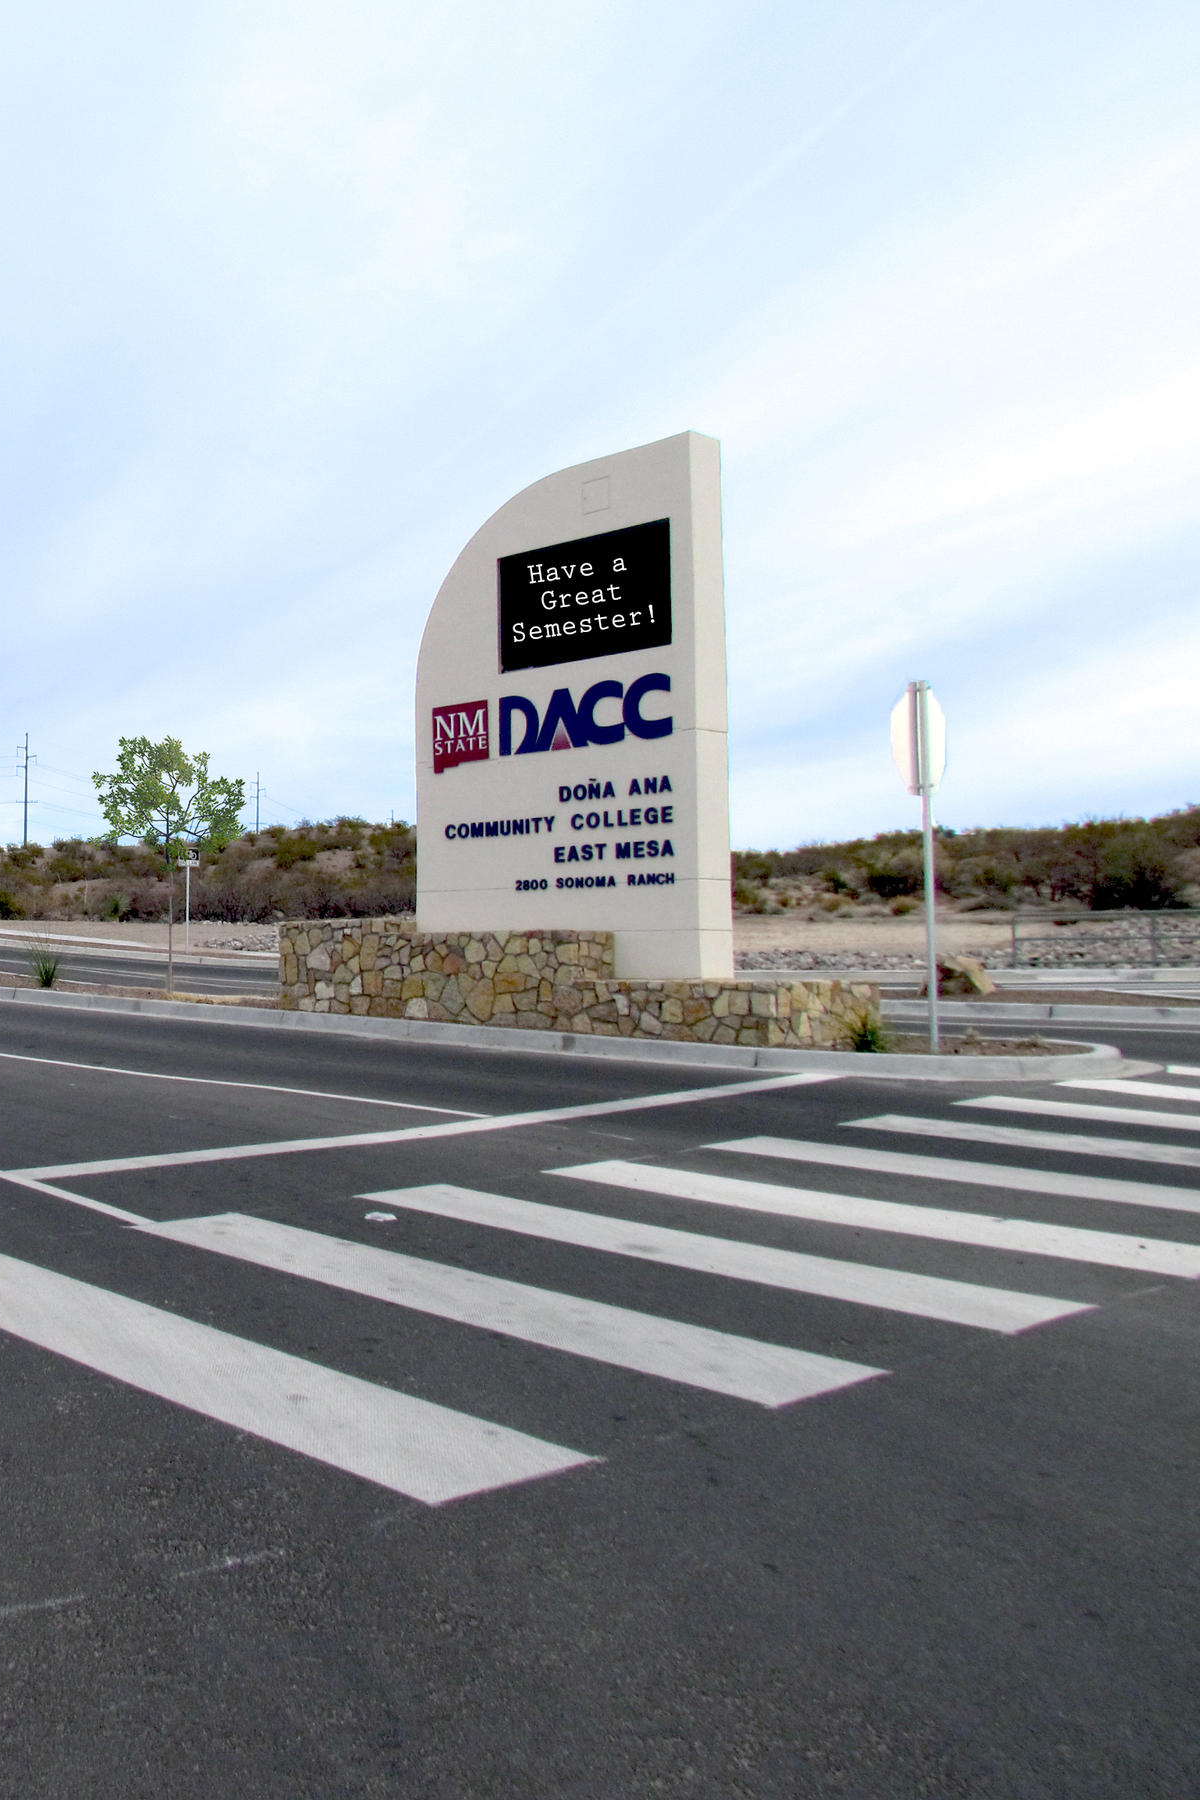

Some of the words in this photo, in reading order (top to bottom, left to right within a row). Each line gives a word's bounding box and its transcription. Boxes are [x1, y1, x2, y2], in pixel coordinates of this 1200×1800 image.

[527, 563, 594, 584] Have
[612, 557, 628, 573] a
[540, 583, 622, 610] Great
[512, 604, 657, 643] Semester!
[434, 710, 487, 739] NM
[499, 672, 673, 756] DACC
[434, 736, 488, 756] STATE
[558, 778, 615, 803] DOÑA
[628, 775, 673, 797] ANA
[445, 816, 555, 840] COMMUNITY
[571, 806, 673, 830] COLLEGE
[554, 843, 607, 863] EAST
[615, 840, 674, 859] MESA
[515, 879, 548, 891] 2800
[556, 876, 616, 889] SONOMA
[627, 873, 675, 887] RANCH
